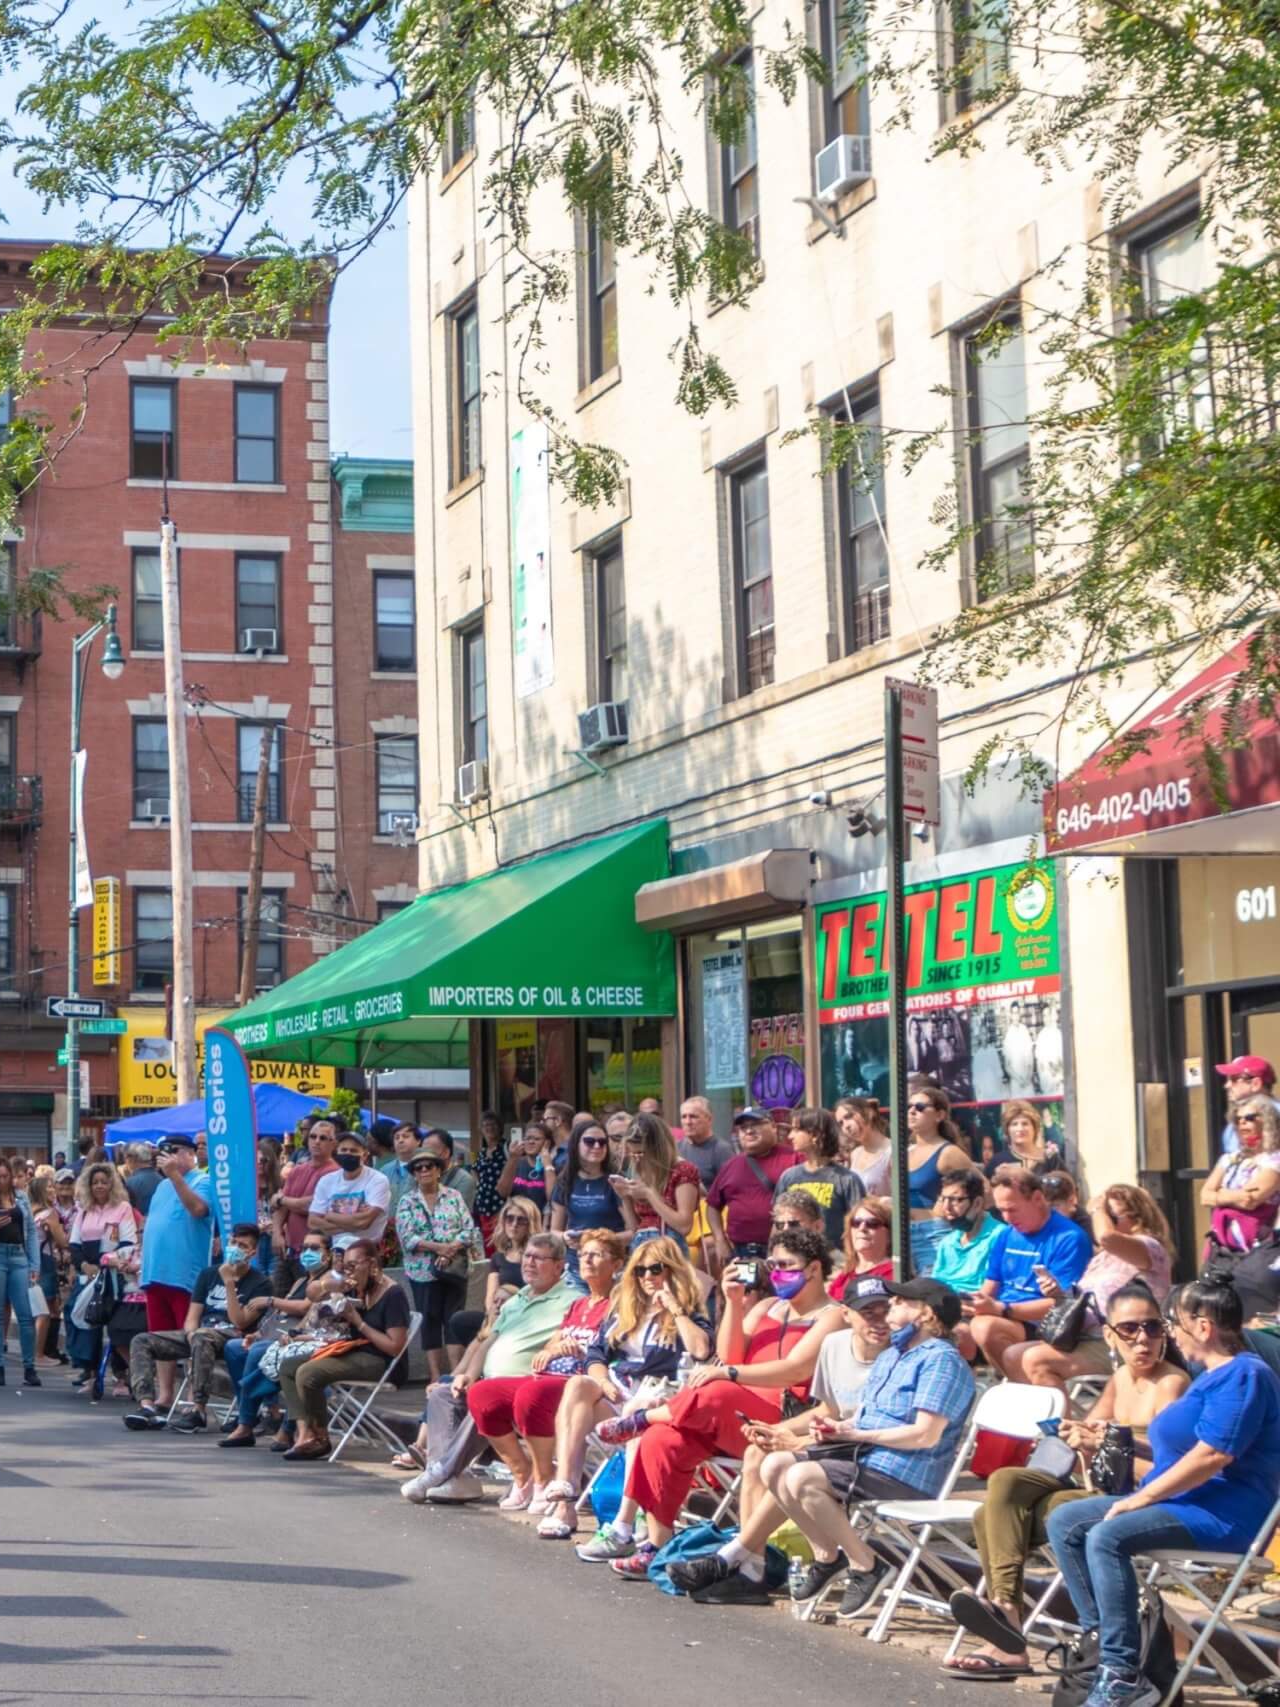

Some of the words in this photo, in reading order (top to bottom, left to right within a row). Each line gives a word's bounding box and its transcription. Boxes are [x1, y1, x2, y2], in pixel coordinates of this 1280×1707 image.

[1056, 778, 1192, 837] 646-402-0405
[1236, 885, 1276, 922] 601
[821, 876, 1003, 1002] TETEL
[429, 987, 514, 1007] IMPORTERS
[519, 987, 538, 1006] OF
[543, 987, 567, 1006] OIL
[572, 987, 581, 1006] &
[586, 987, 644, 1006] CHEESE
[841, 977, 889, 998] BROTHE
[927, 964, 961, 985] SINCE
[967, 957, 1001, 977] 1915
[58, 1003, 75, 1013] ONE
[80, 1005, 96, 1013] WAY
[275, 1011, 318, 1038] WHOLESALE
[322, 1005, 349, 1029] RETAIL
[354, 992, 403, 1021] GROCERIES
[833, 1004, 864, 1019] FOUR
[867, 992, 952, 1017] GENATIONS
[955, 988, 974, 1003] OF
[976, 979, 1036, 1000] QUALITY
[144, 1063, 178, 1079] LOC
[249, 1063, 321, 1080] RDWARE
[208, 1043, 228, 1135] Series
